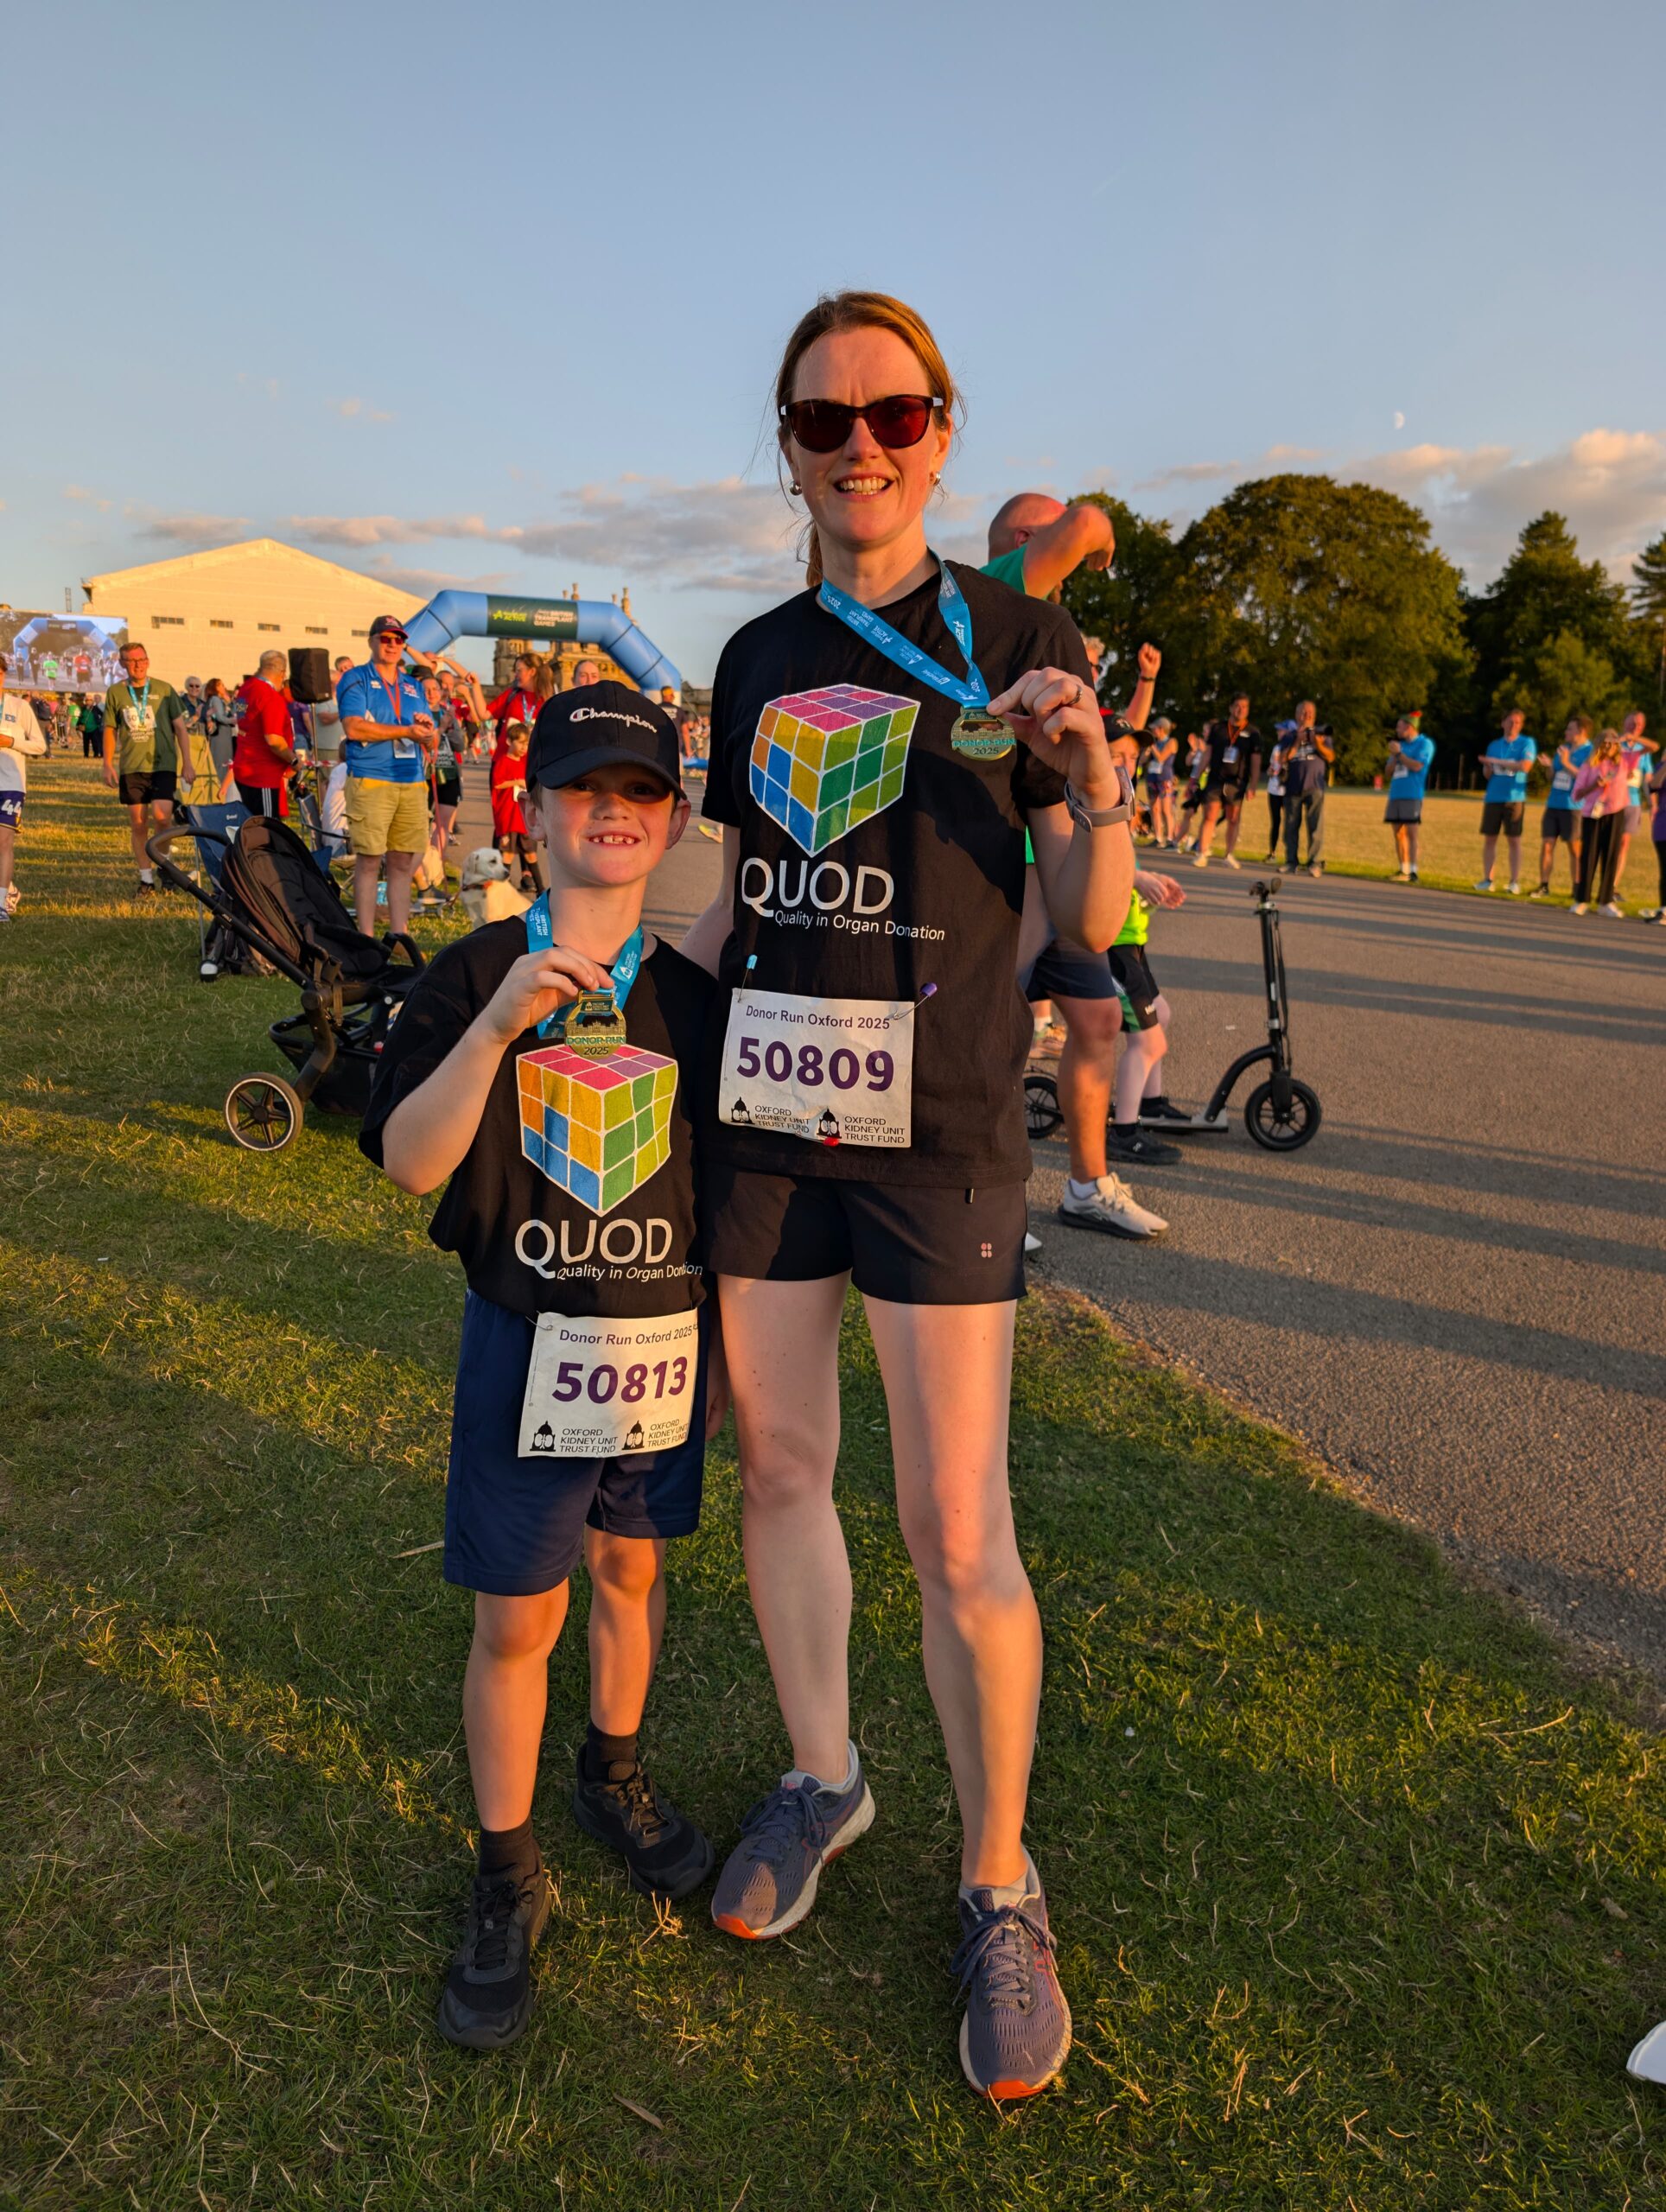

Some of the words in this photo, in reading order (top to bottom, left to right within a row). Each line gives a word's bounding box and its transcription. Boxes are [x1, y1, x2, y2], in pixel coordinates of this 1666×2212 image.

[827, 595, 842, 610] 2025
[569, 707, 658, 734] Champion
[741, 857, 894, 918] QUOD
[775, 910, 813, 929] Quality
[817, 912, 828, 927] in
[833, 915, 879, 935] Organ
[885, 920, 945, 941] Donation
[746, 1005, 778, 1020] Donor
[780, 1010, 804, 1024] Run
[808, 1014, 853, 1028] Oxford
[857, 1017, 890, 1030] 2025
[566, 1036, 605, 1045] DONOR
[606, 1036, 626, 1045] RUN
[584, 1046, 609, 1055] 2025
[736, 1036, 894, 1092] 50809
[754, 1105, 792, 1116] OXFORD
[754, 1113, 787, 1122] KIDNEY
[787, 1123, 810, 1134] FUND
[844, 1116, 887, 1126] OXFORD
[844, 1124, 881, 1134] KIDNEY
[882, 1127, 906, 1135] UNIT
[844, 1133, 876, 1142] TRUST
[878, 1135, 905, 1144] FUND
[515, 1218, 673, 1280] QUOD
[557, 1263, 605, 1281] Quality
[609, 1265, 622, 1279] in
[626, 1267, 664, 1283] Organ
[560, 1329, 602, 1344] Donor
[606, 1333, 632, 1345] Run
[635, 1332, 671, 1344] Oxford
[673, 1325, 692, 1340] 2025
[551, 1356, 688, 1404] 50813
[648, 1428, 675, 1440] KIDNEY
[676, 1423, 689, 1434] UNIT
[650, 1419, 680, 1431] OXFORD
[561, 1436, 596, 1445] KIDNEY
[597, 1436, 618, 1445] UNIT
[647, 1438, 670, 1447] TRUST
[671, 1432, 687, 1444] FUND
